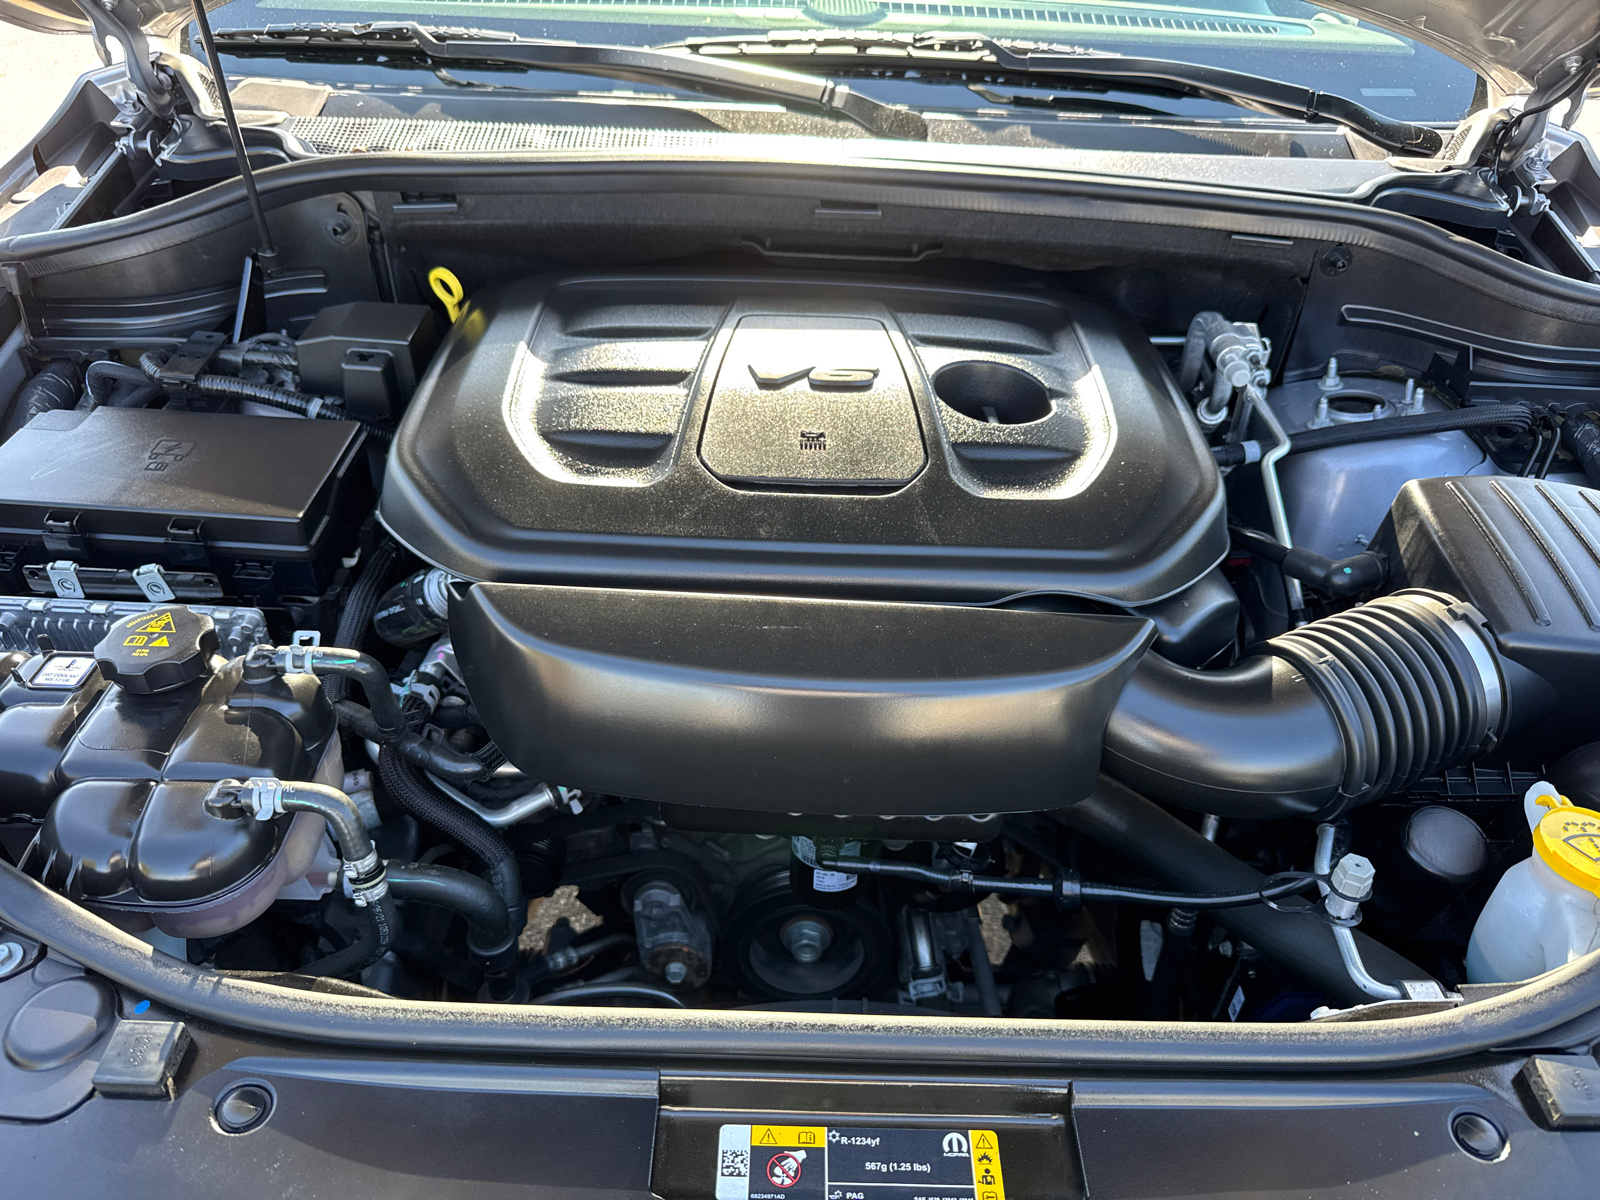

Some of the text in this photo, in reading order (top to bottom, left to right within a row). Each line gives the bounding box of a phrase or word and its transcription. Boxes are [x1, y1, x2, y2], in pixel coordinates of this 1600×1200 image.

[747, 364, 880, 389] V6
[841, 1137, 880, 1147] R-1234yf
[865, 1162, 931, 1173] 567g (1.25 lbs)
[846, 1192, 865, 1200] PAG
